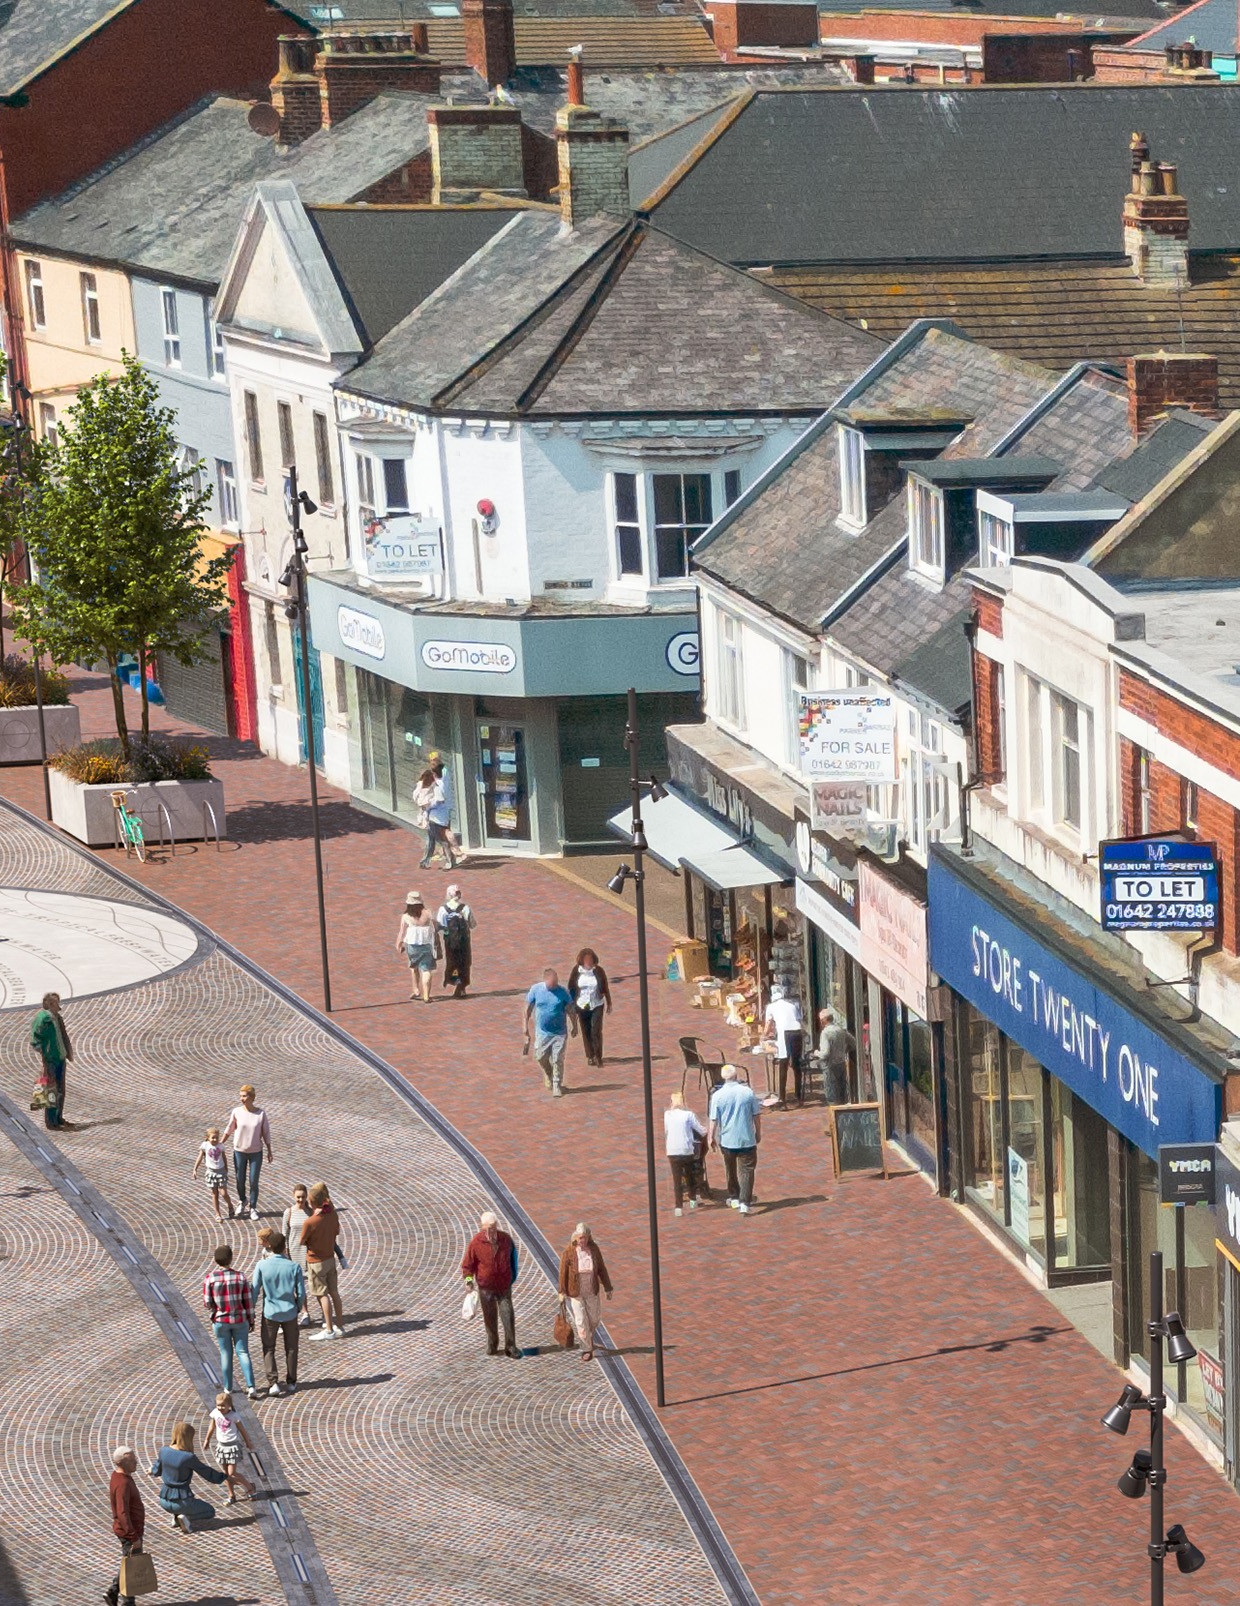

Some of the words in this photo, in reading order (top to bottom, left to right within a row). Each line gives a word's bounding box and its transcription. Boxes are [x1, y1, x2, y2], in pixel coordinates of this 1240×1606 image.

[381, 544, 404, 558] TO
[409, 543, 437, 557] LET
[428, 646, 510, 667] GoMobile
[821, 741, 850, 754] FOR
[855, 742, 891, 755] SALE
[1122, 881, 1153, 898] TO
[1160, 881, 1196, 898] LET
[1105, 903, 1154, 919] 01642
[971, 925, 1023, 1013] STORE
[1028, 970, 1110, 1083] TWENTY
[1118, 1044, 1160, 1126] ONE
[1169, 1159, 1212, 1173] YMCA
